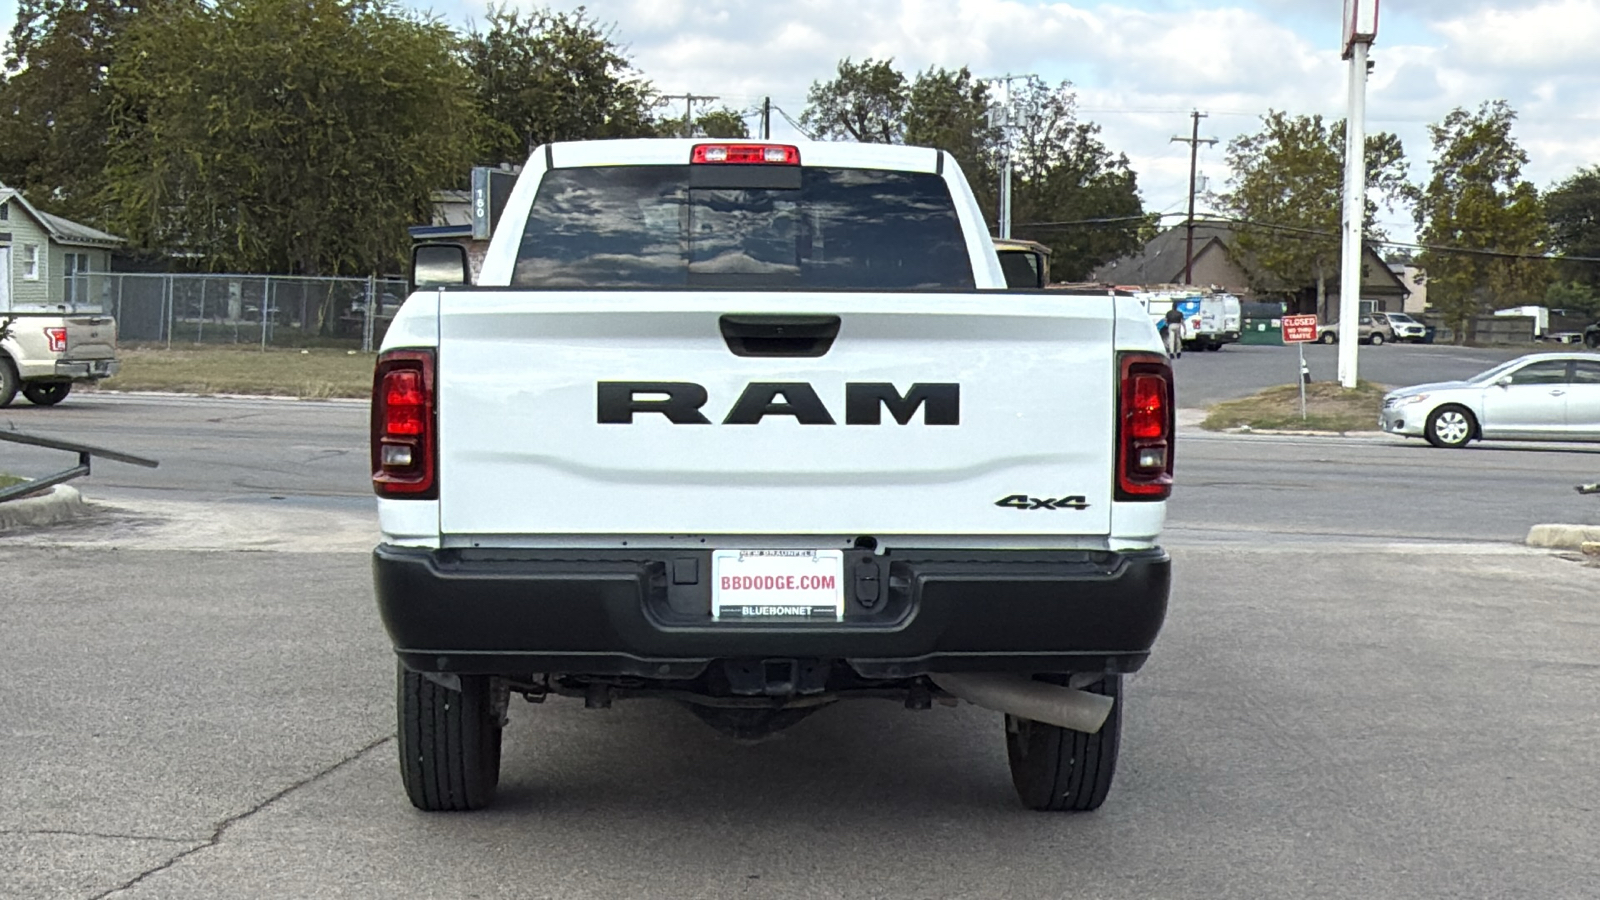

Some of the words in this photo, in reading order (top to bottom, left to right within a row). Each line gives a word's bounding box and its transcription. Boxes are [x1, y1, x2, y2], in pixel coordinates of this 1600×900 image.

[476, 189, 485, 218] 160
[1284, 318, 1315, 326] CLOSED
[597, 381, 960, 425] RAM
[994, 494, 1091, 510] 4x4
[721, 575, 835, 590] BBDODGE.COM
[742, 606, 812, 616] BLUEBONNET
